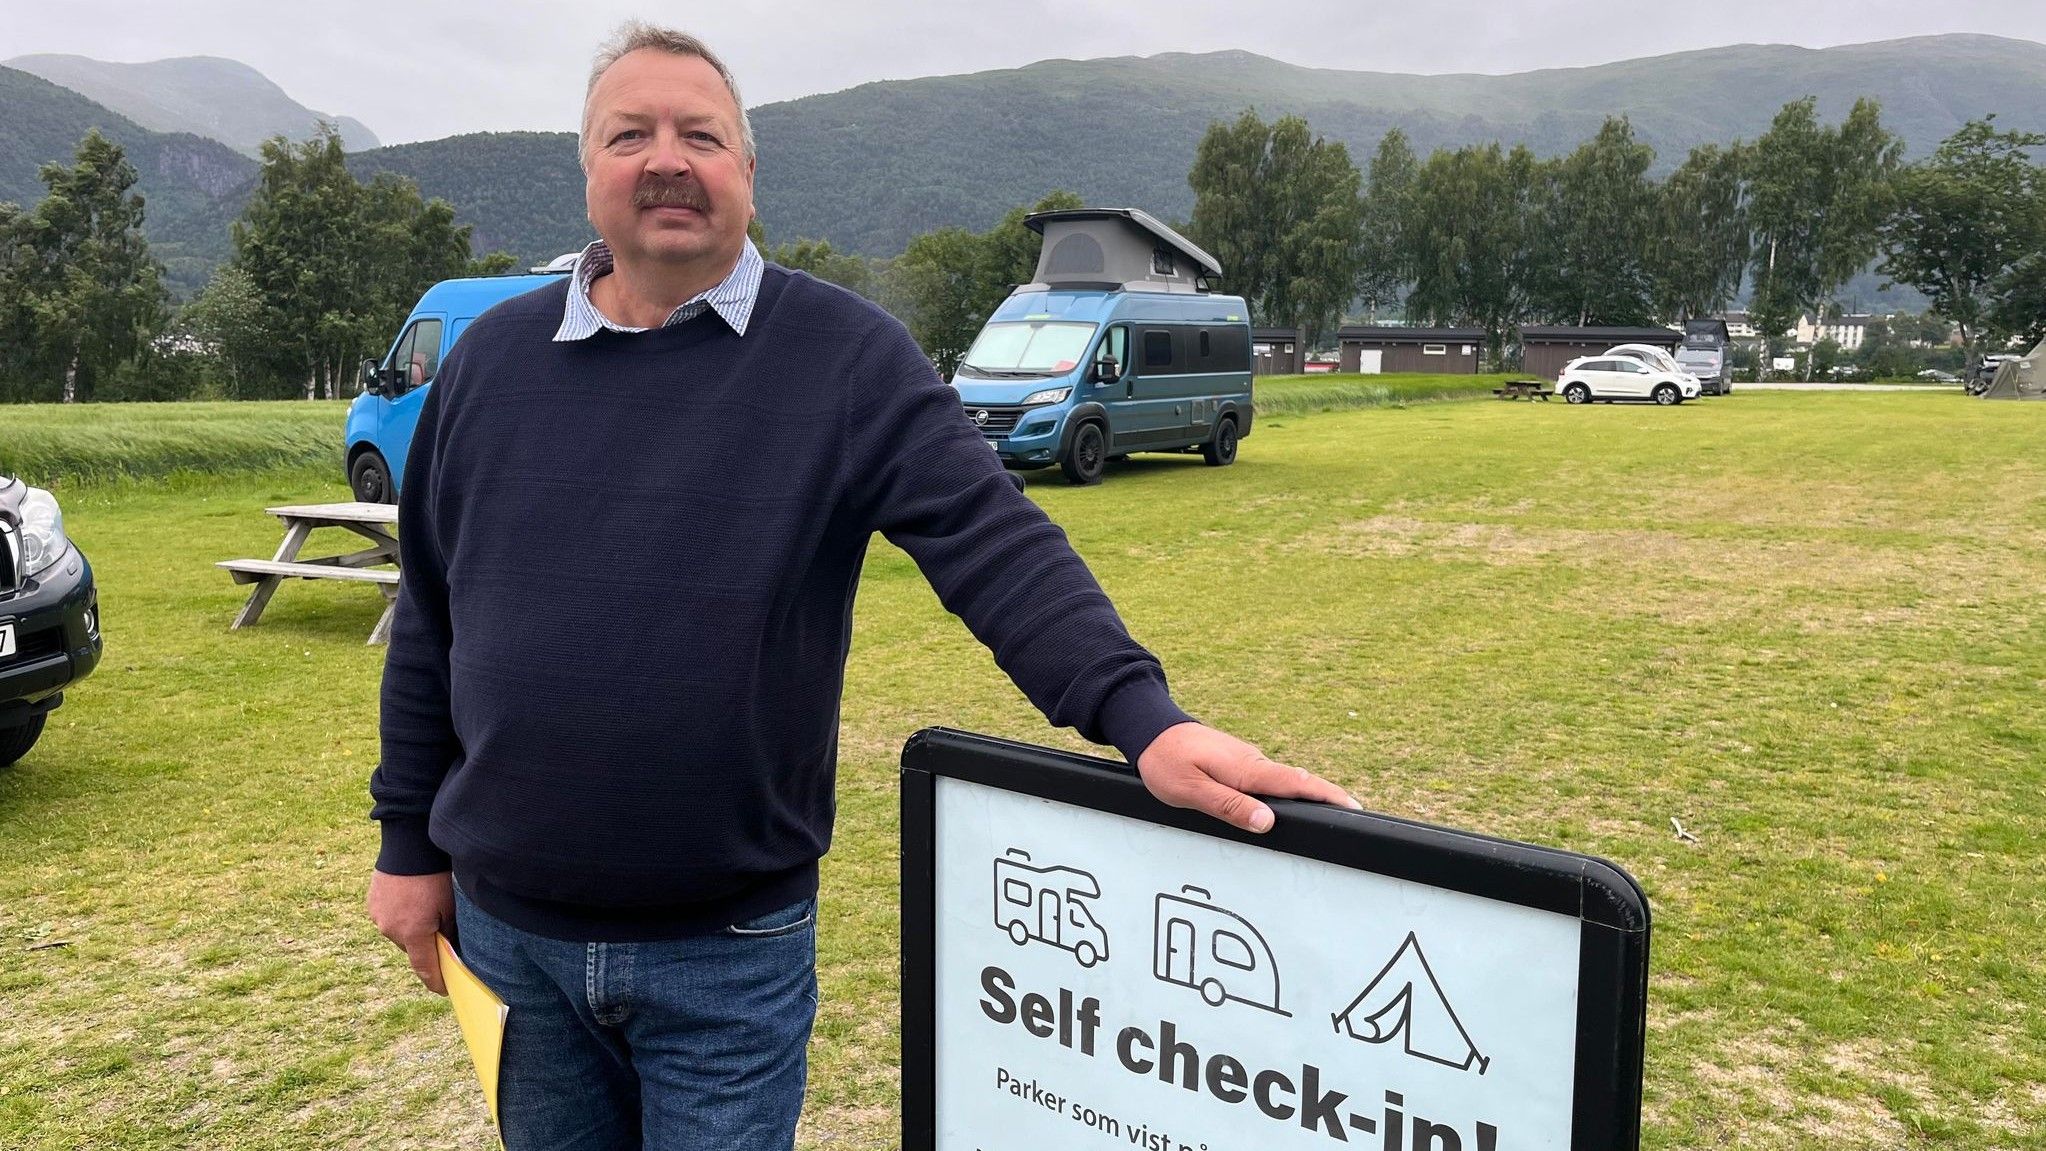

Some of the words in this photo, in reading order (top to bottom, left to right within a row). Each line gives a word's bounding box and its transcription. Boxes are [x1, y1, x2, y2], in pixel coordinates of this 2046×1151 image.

[979, 966, 1100, 1057] Self
[997, 1067, 1066, 1114] Parker
[1072, 1103, 1119, 1137] som
[1127, 1124, 1171, 1151] vist
